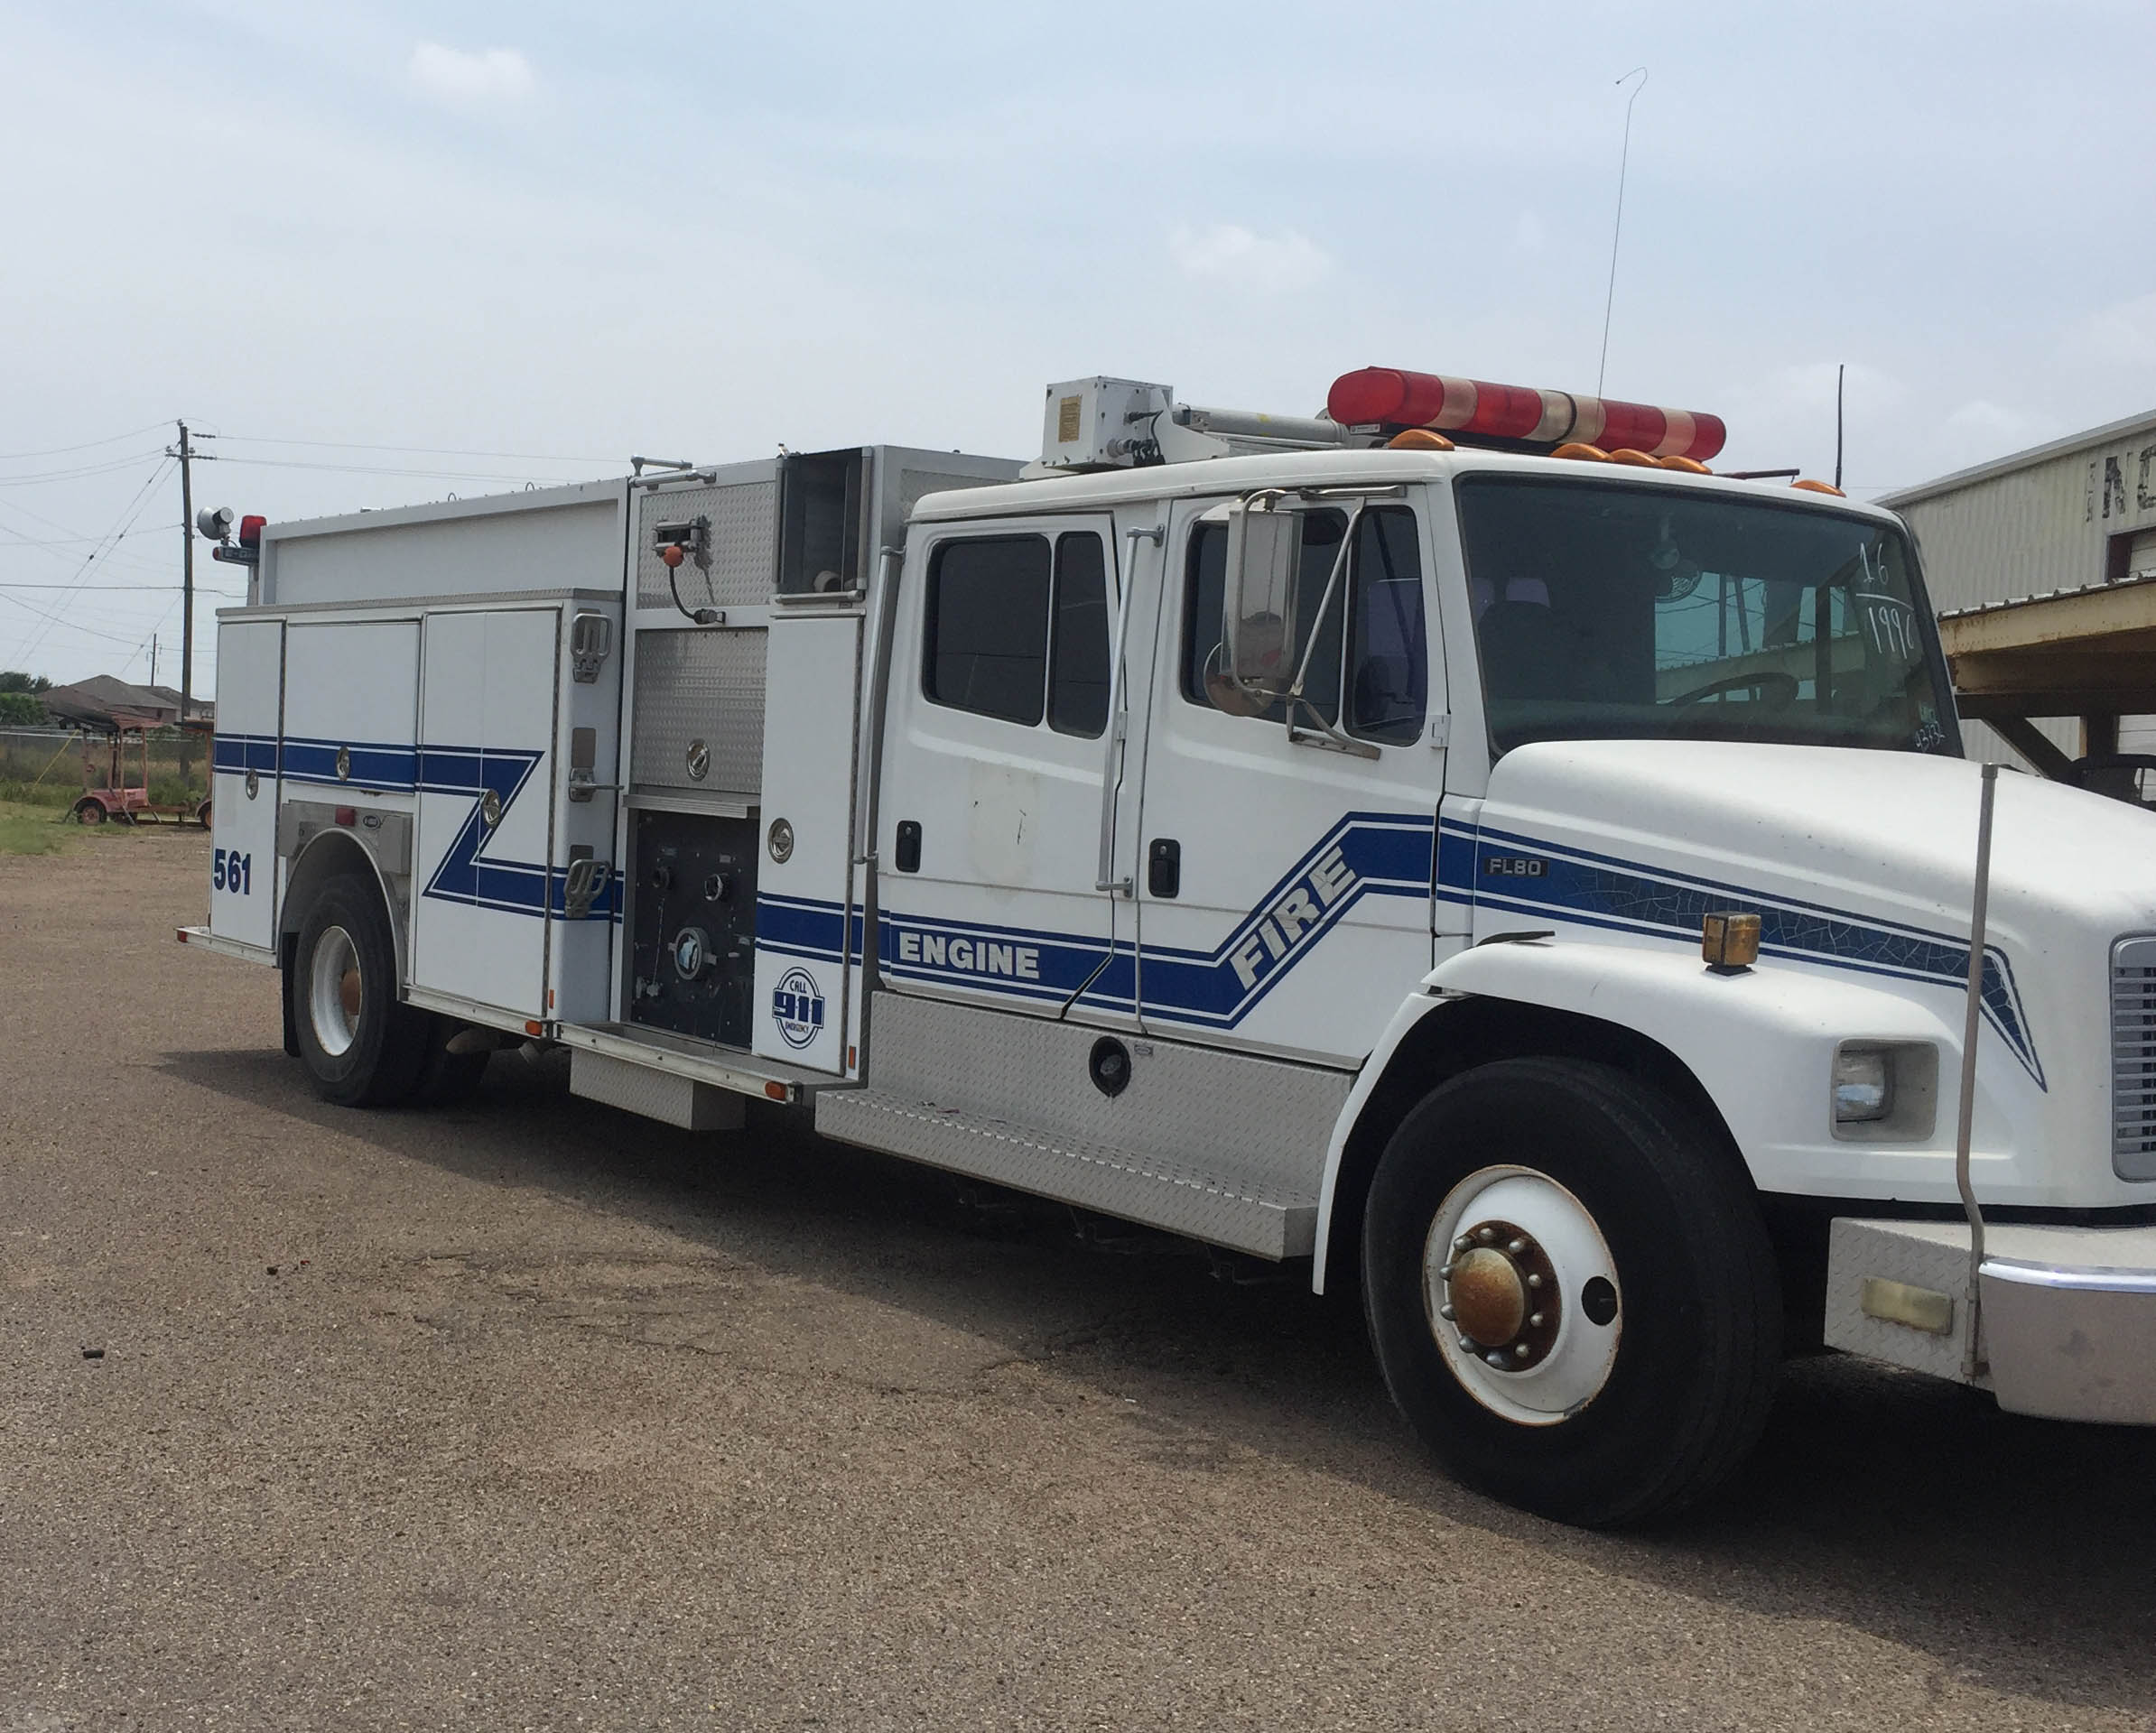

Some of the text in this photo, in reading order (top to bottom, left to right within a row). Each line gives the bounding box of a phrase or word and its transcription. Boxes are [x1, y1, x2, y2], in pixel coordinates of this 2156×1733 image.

[1860, 542, 1889, 585] 16
[213, 848, 252, 895] 561
[1489, 858, 1541, 876] FL80
[1229, 845, 1356, 991] FIRE
[899, 931, 1040, 979] ENGINE
[789, 979, 807, 994] CALL
